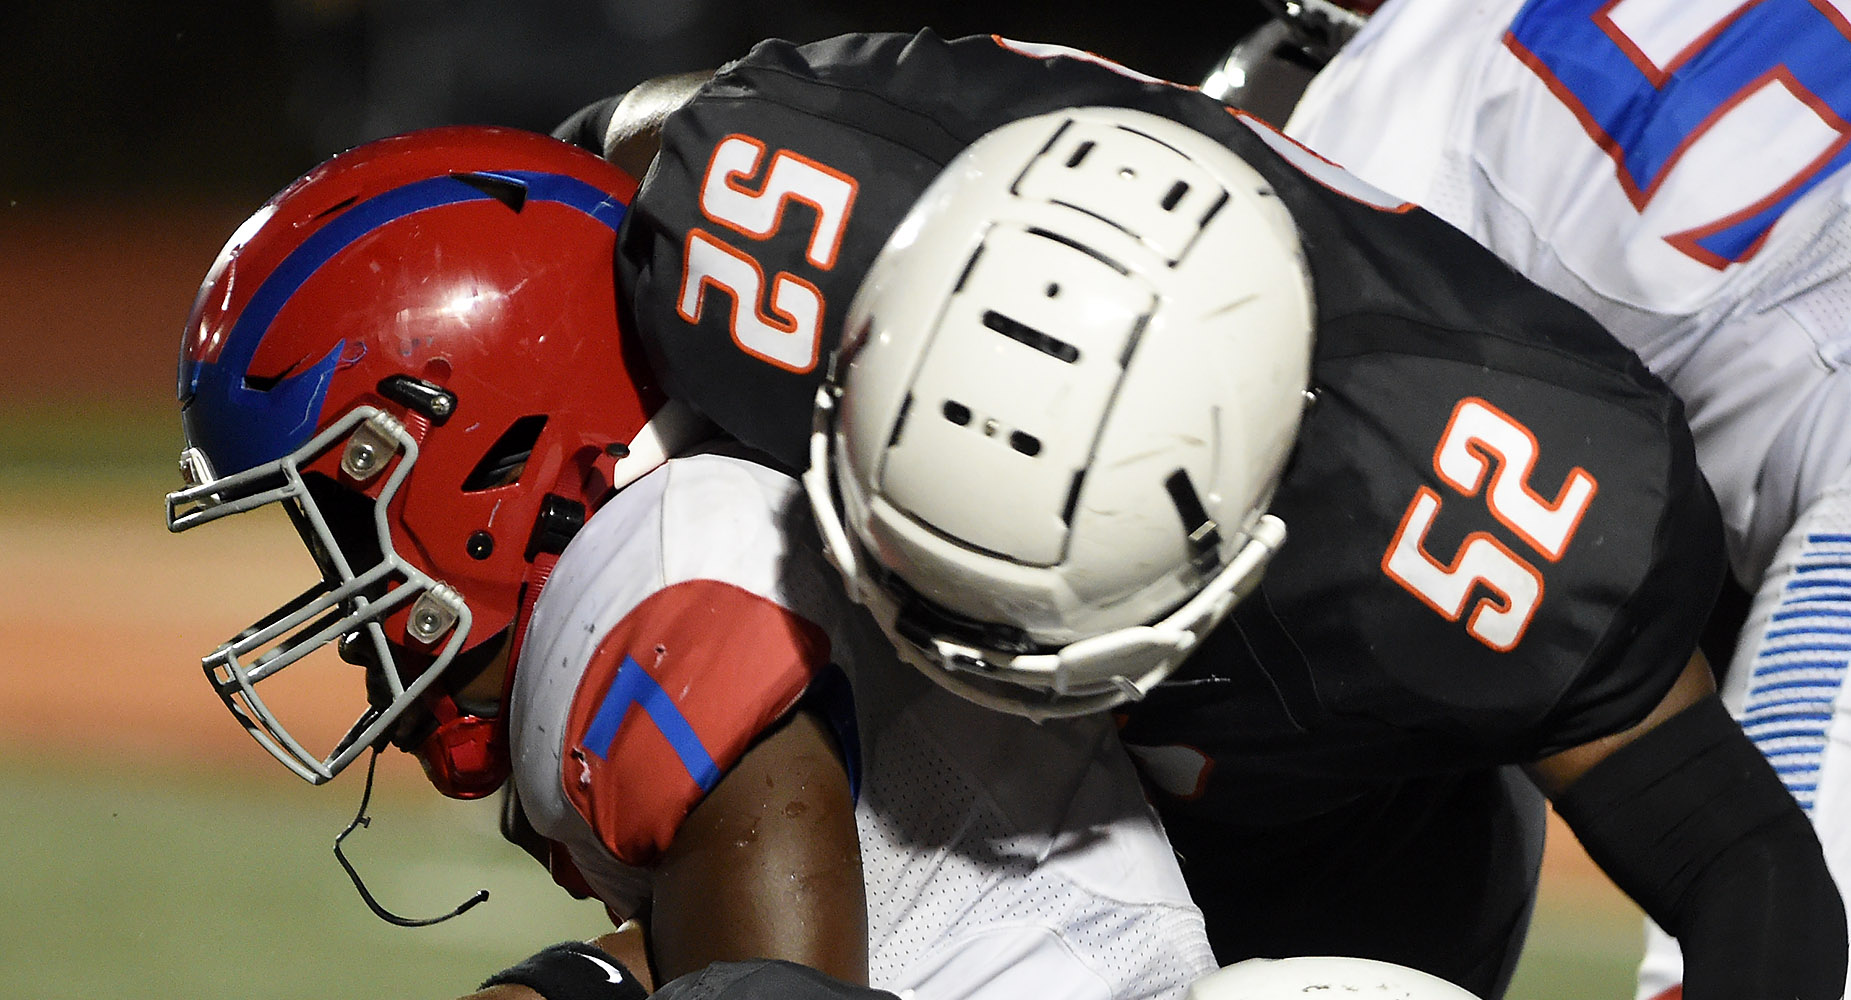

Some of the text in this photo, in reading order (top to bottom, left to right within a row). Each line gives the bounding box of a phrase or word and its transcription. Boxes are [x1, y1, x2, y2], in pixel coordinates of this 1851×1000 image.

[676, 133, 860, 375] 52
[1380, 396, 1598, 653] 52
[582, 653, 721, 792] 7
